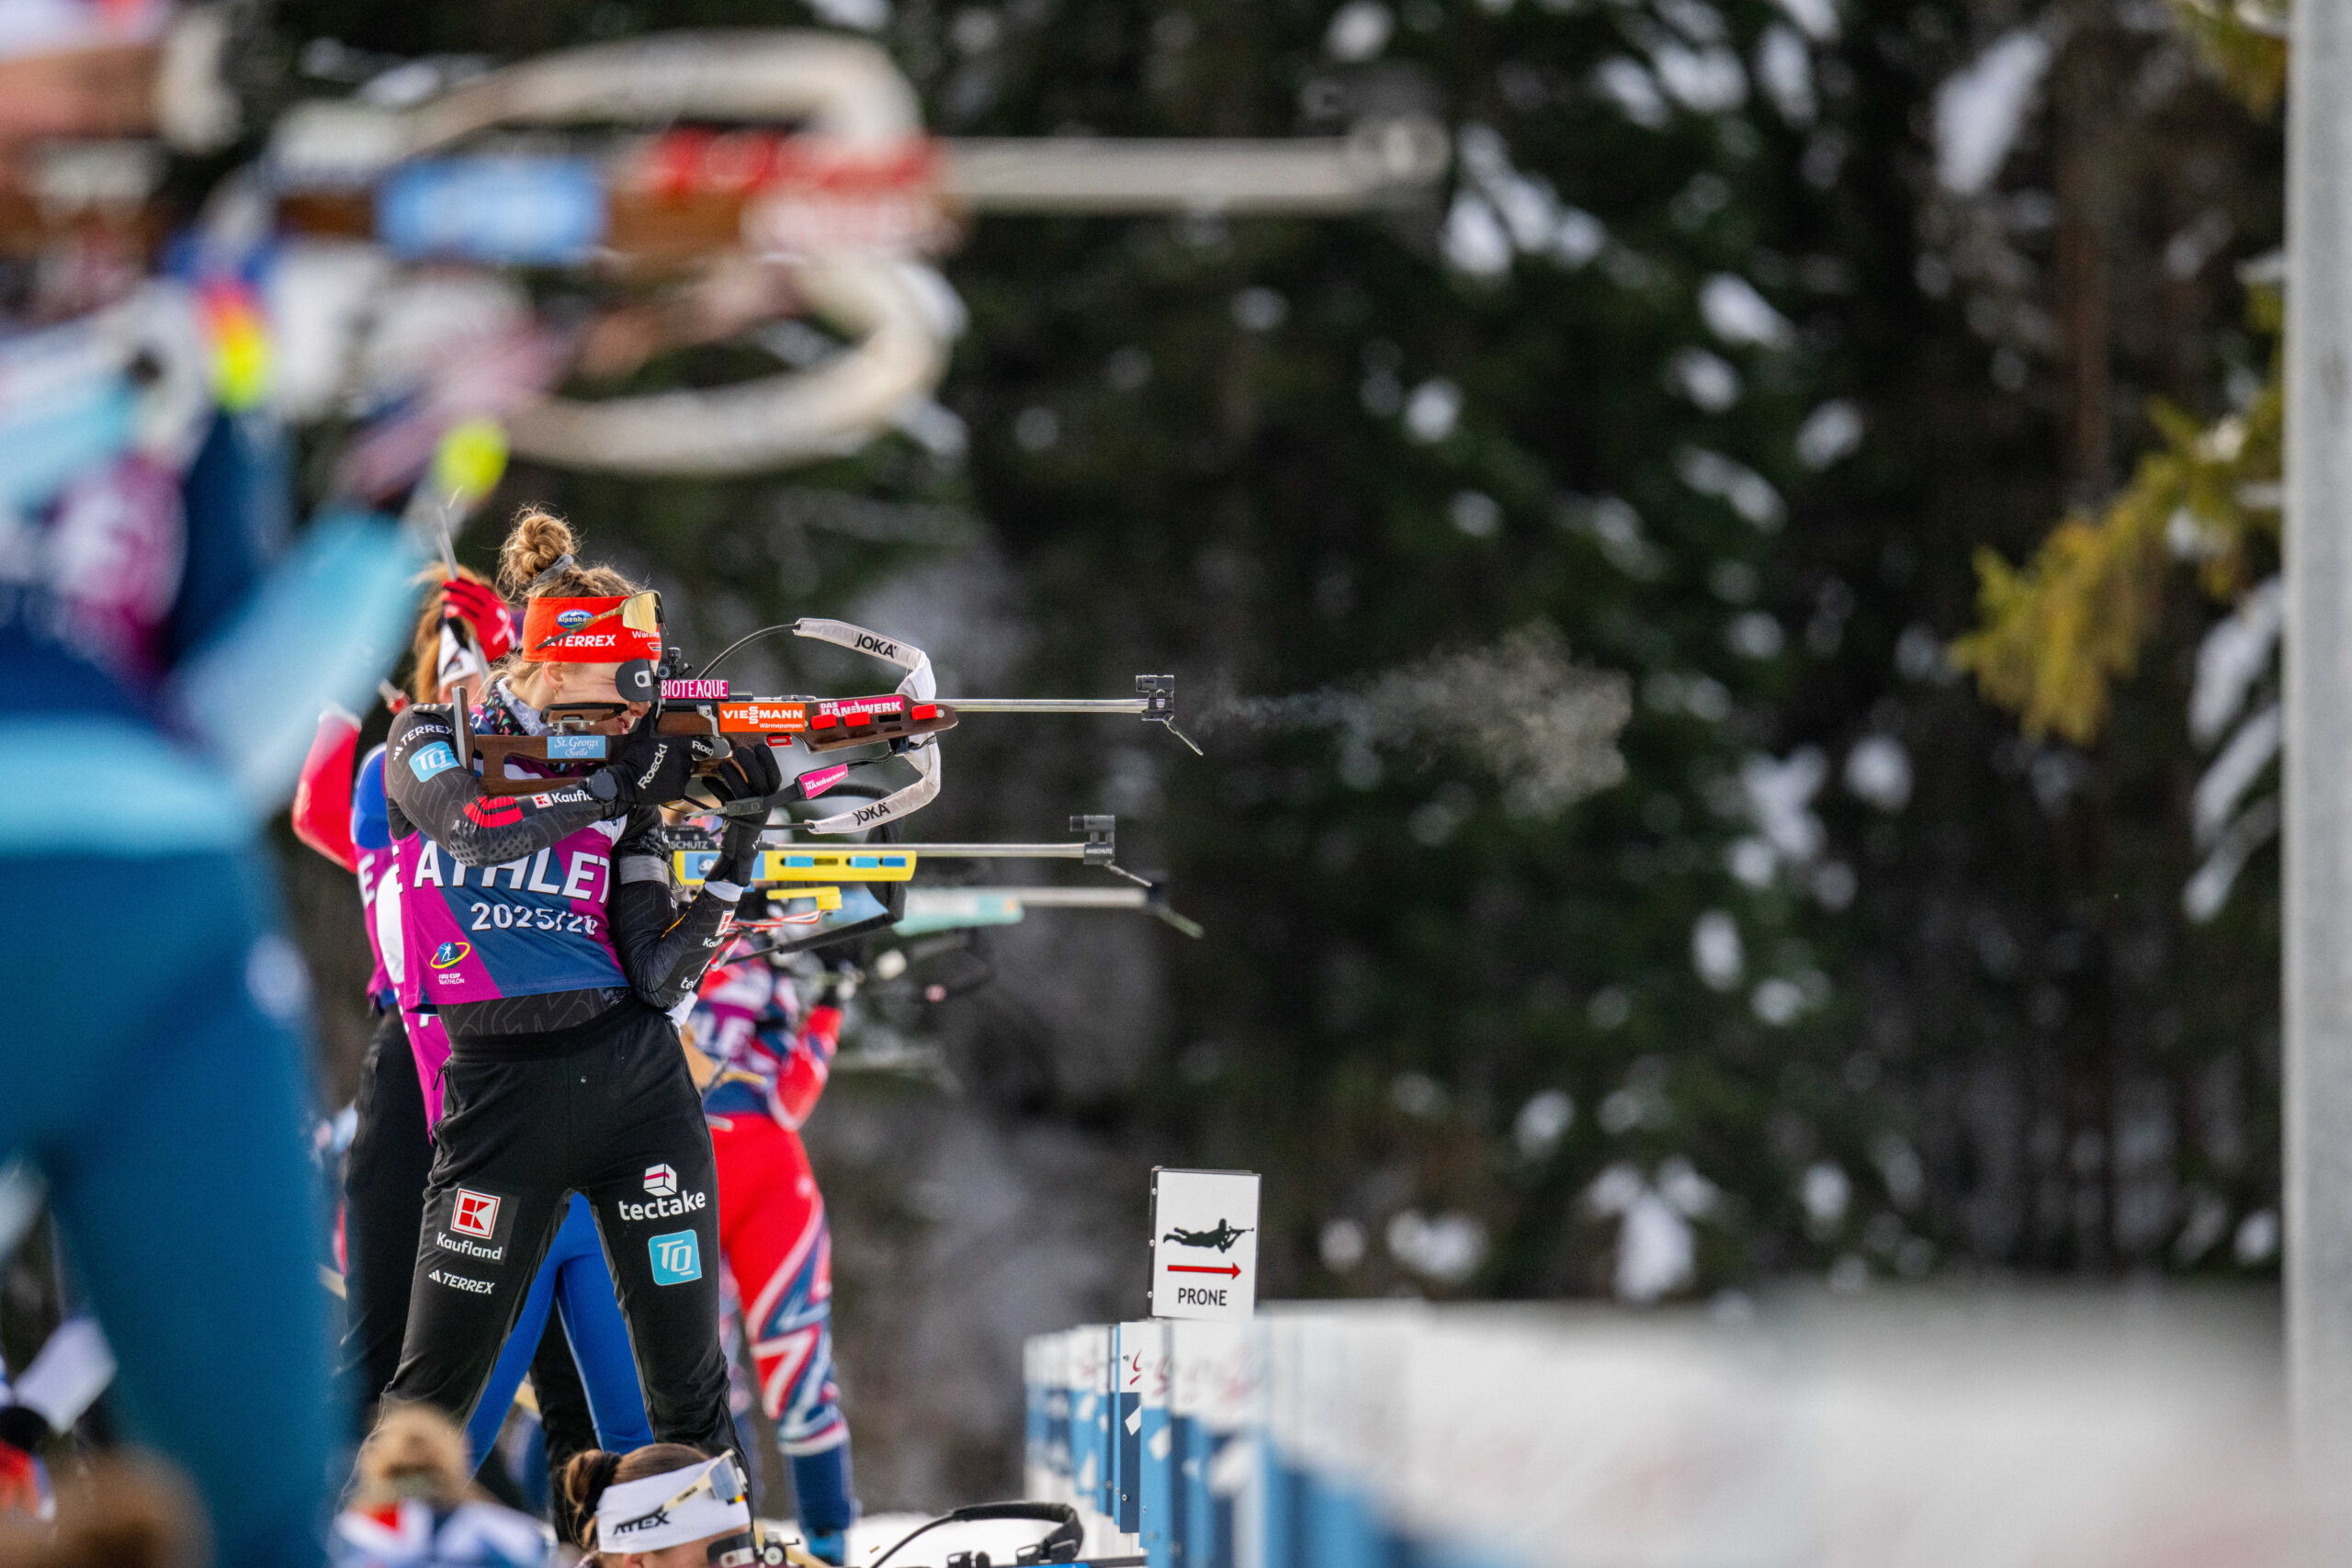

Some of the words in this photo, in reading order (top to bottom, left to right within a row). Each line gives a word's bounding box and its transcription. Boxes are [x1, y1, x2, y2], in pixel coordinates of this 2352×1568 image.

[661, 680, 729, 698] BIOTEAQUE
[722, 705, 803, 725] VIESSMANN
[400, 724, 456, 747] TERREX
[554, 736, 568, 749] St.
[569, 736, 599, 750] Georgs
[565, 749, 588, 758] Quelle
[551, 789, 594, 804] Kaufl
[852, 802, 891, 827] JOKA
[618, 1190, 706, 1221] tectake
[436, 1232, 503, 1261] Kaufland
[657, 1239, 695, 1277] TQ
[442, 1271, 495, 1295] TERREX
[1178, 1288, 1227, 1306] PRONE
